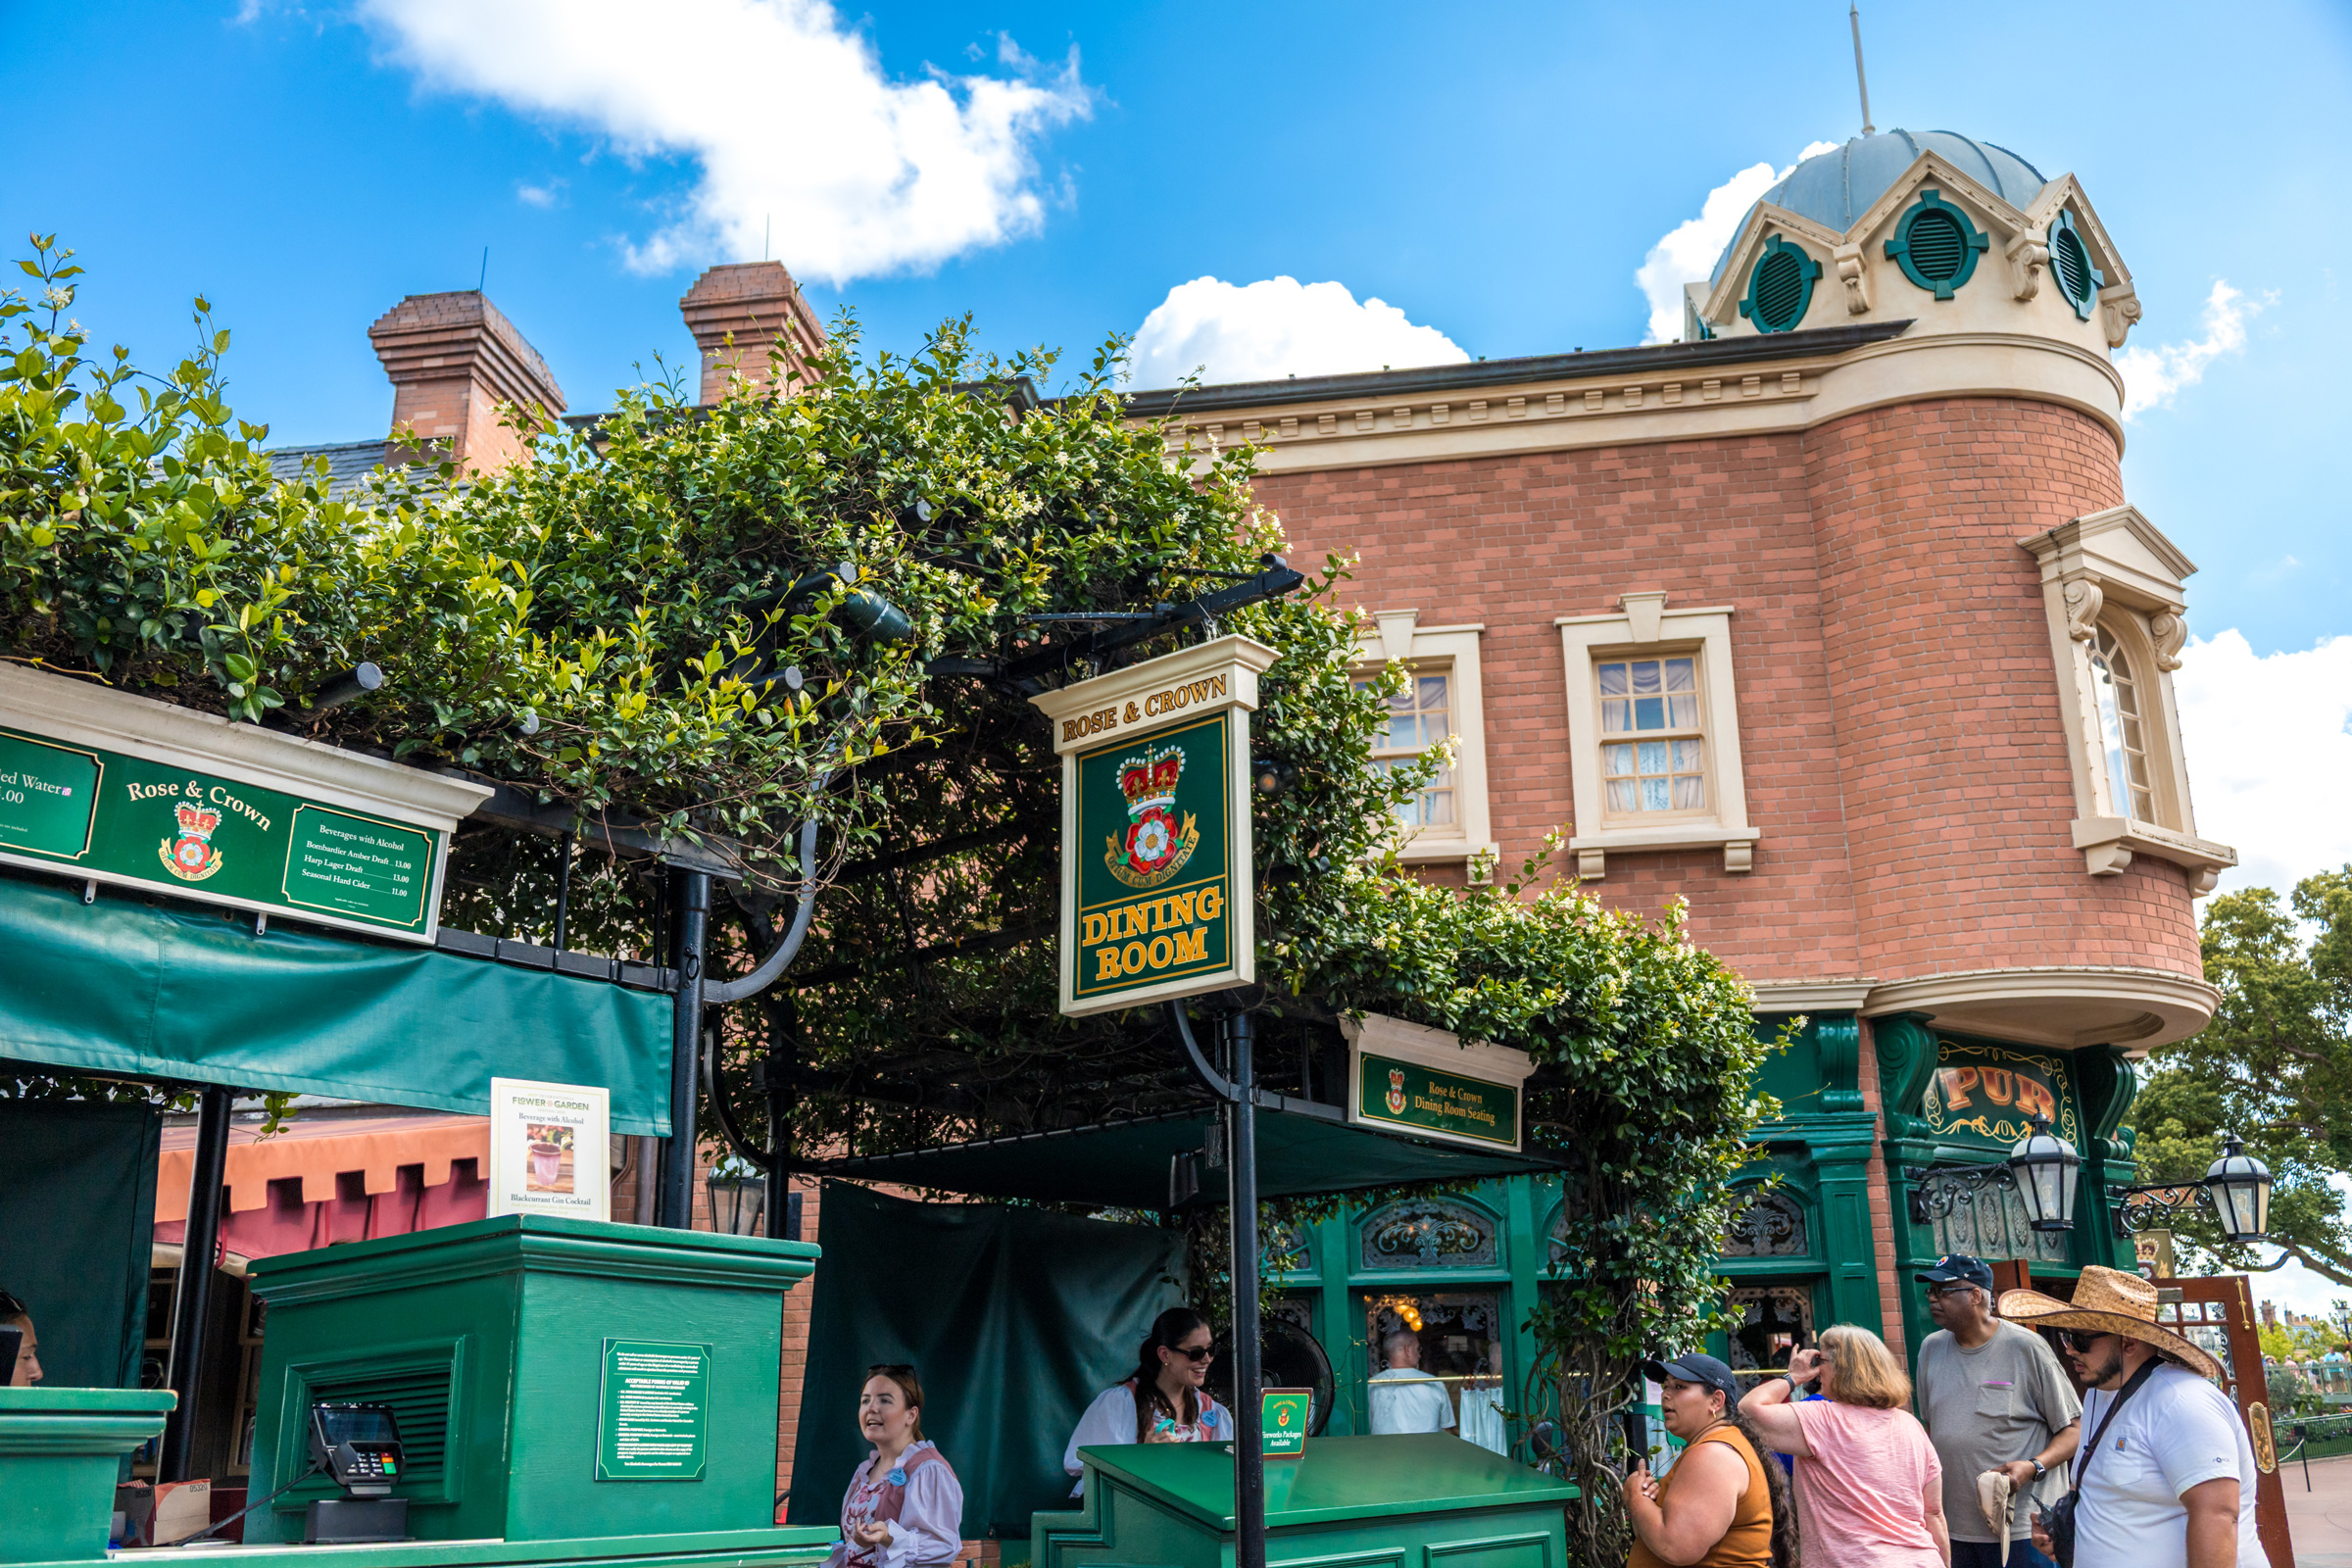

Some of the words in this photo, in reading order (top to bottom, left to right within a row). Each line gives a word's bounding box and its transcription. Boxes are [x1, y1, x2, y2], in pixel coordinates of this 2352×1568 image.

[1062, 707, 1117, 743] ROSE
[1123, 701, 1141, 724] &
[1145, 673, 1226, 717] CROWN
[22, 774, 62, 795] Water
[126, 782, 179, 802] Rose
[185, 780, 203, 798] &
[209, 786, 272, 831] Crown
[319, 824, 357, 841] Beverages
[359, 835, 374, 845] with
[376, 838, 405, 851] Alcohol
[304, 855, 323, 866] Harp
[324, 858, 344, 870] Lager
[345, 863, 364, 874] Draft
[393, 874, 410, 883] 13.00
[306, 841, 347, 857] Bombardier
[347, 850, 370, 861] Amber
[371, 855, 390, 865] Draft
[395, 860, 412, 870] 13.00
[1107, 856, 1131, 882] OTIUM
[1132, 875, 1152, 886] CUM
[1156, 836, 1196, 883] DIGNITATE
[302, 868, 332, 882] Seasonal
[333, 875, 351, 886] Hard
[352, 878, 370, 890] Cider
[392, 888, 408, 897] 11.00
[1082, 885, 1224, 947] DINING
[1096, 926, 1208, 981] ROOM
[512, 1097, 546, 1107] FLOWER
[554, 1101, 590, 1110] GARDEN
[1429, 1081, 1447, 1097] Rose
[1449, 1086, 1456, 1099] &
[1457, 1088, 1483, 1103] Crown
[1939, 1066, 2056, 1125] PUB
[518, 1112, 546, 1122] Beverage
[1415, 1096, 1443, 1116] Dining
[1445, 1102, 1466, 1117] Room
[1468, 1106, 1495, 1126] Seating
[511, 1194, 551, 1203] Blackcurrant
[565, 1197, 591, 1205] Cocktail
[1283, 1431, 1301, 1440] Packages
[189, 1483, 208, 1493] 05320
